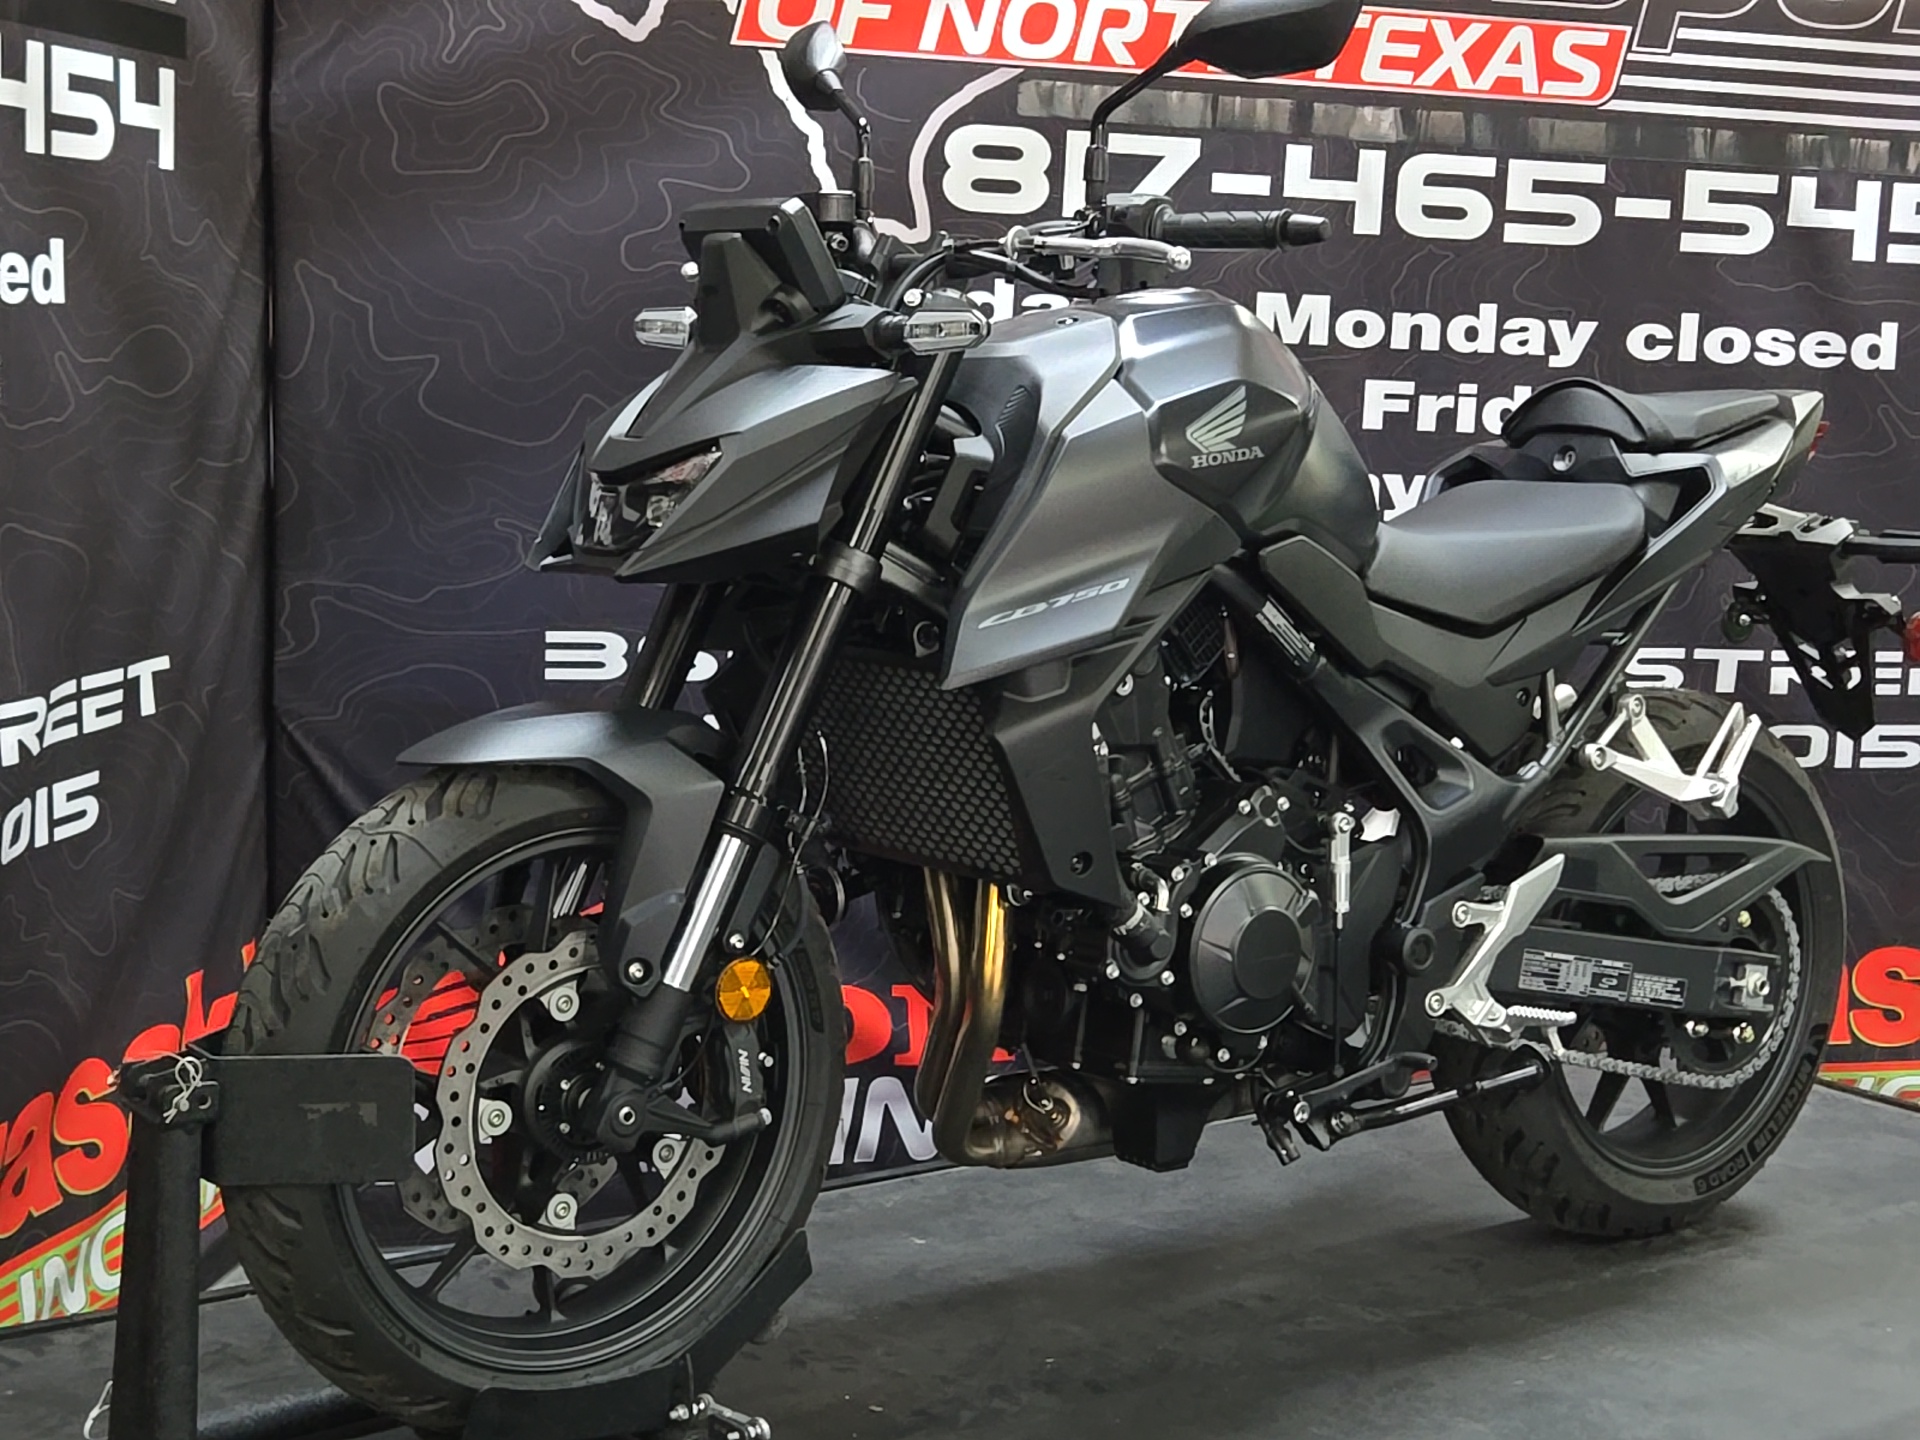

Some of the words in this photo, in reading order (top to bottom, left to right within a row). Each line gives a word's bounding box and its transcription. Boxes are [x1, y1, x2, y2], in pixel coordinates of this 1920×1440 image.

[757, 0, 892, 46] OF
[917, 0, 1211, 66] NORT
[1314, 12, 1610, 97] EXAS
[0, 39, 175, 171] 454
[0, 237, 66, 305] ed
[1255, 291, 1599, 368] Monday
[1626, 312, 1898, 371] closed
[1361, 379, 1532, 435] Frid
[1190, 445, 1265, 469] HONDA
[0, 655, 171, 767] REET
[1768, 724, 1920, 768] 015
[0, 770, 100, 865] 015
[1708, 1153, 1748, 1187] ROAD
